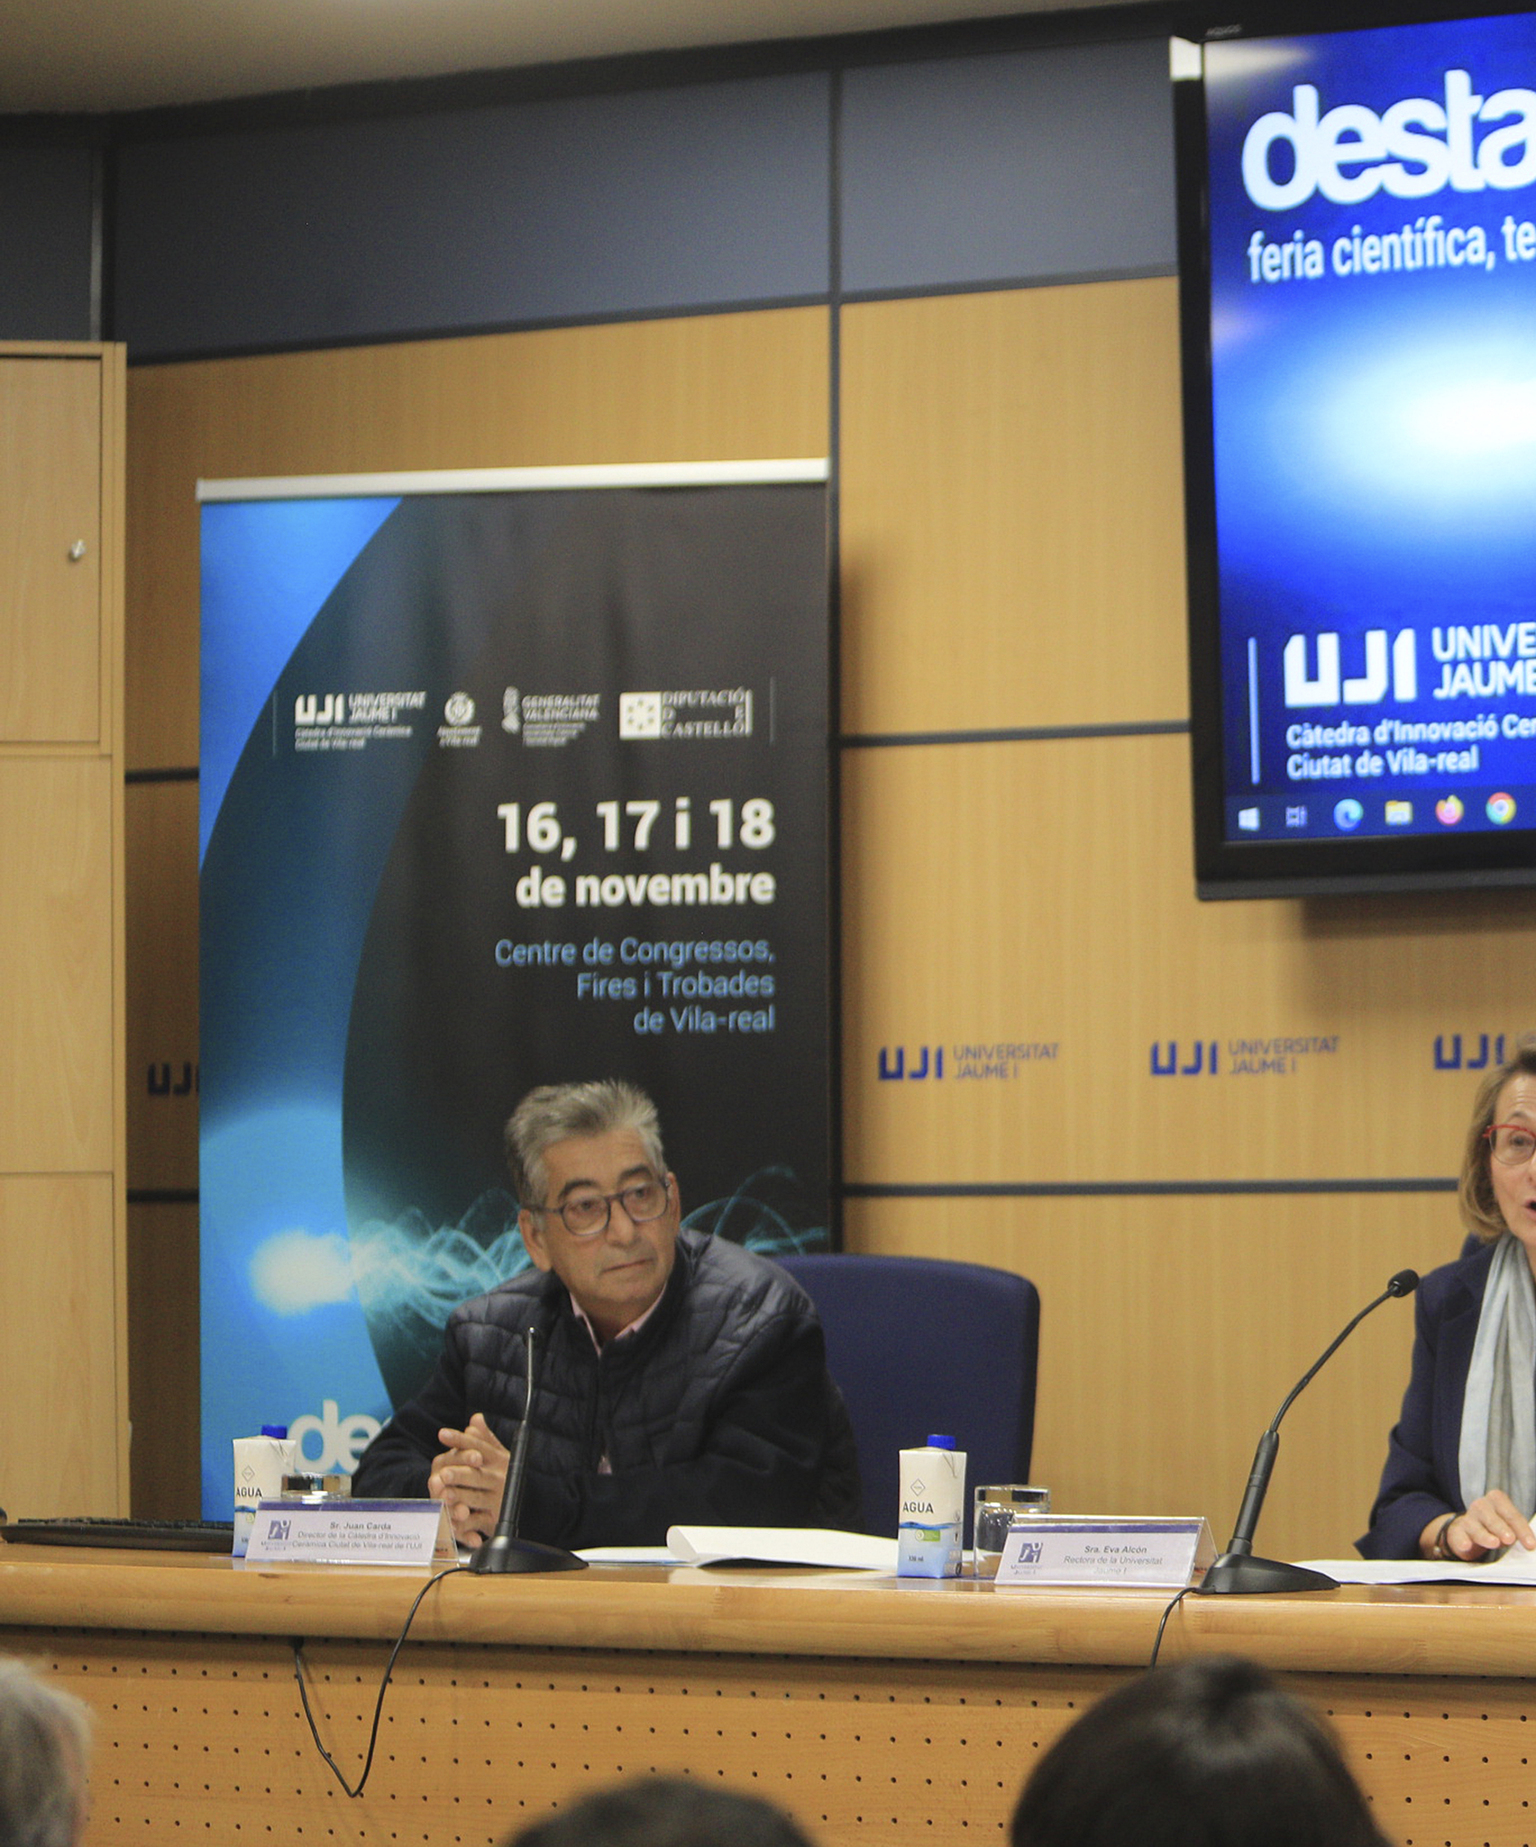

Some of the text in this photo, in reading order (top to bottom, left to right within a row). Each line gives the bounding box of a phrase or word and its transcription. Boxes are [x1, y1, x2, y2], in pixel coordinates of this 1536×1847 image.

[1248, 229, 1325, 282] feria
[1331, 217, 1497, 278] científica,
[1284, 628, 1417, 707] UJI
[349, 691, 427, 710] UNIVERSITAT
[522, 694, 599, 709] GENERALITAT
[662, 687, 745, 707] DIPUTACIÓ
[295, 693, 345, 726] UJI
[350, 706, 390, 724] JAUME
[523, 707, 598, 722] VALENCIANA
[662, 707, 676, 722] D
[662, 719, 745, 739] CASTELLÓ
[1286, 720, 1369, 749] Càtedra
[1374, 713, 1496, 745] d'Innovació
[1286, 746, 1479, 779] Ciutat de Vila-real
[497, 797, 776, 861] 16, 17 i 18
[516, 863, 776, 908] de novembre
[495, 937, 775, 968] Centre de Congressos,
[577, 972, 775, 999] Fires i Trobades
[633, 1006, 775, 1034] de Vila-real
[953, 1043, 1059, 1061] UNIVERSITAT
[1228, 1036, 1340, 1056] UNIVERSITAT
[1434, 1033, 1505, 1070] UJI
[878, 1046, 944, 1081] UJI
[1150, 1040, 1218, 1076] UJI
[1229, 1057, 1297, 1075] JAUME I
[955, 1062, 1018, 1080] JAUME I
[236, 1487, 262, 1497] AGUA
[903, 1501, 934, 1514] AGUA
[367, 1522, 391, 1530] Carda
[329, 1540, 349, 1548] Ciutat
[352, 1540, 361, 1548] de
[395, 1541, 404, 1549] de
[1084, 1546, 1100, 1554] Sra.
[1122, 1545, 1147, 1553] Alcón
[1064, 1556, 1163, 1565] Rectora de la Universitat
[1094, 1567, 1121, 1575] Jaume
